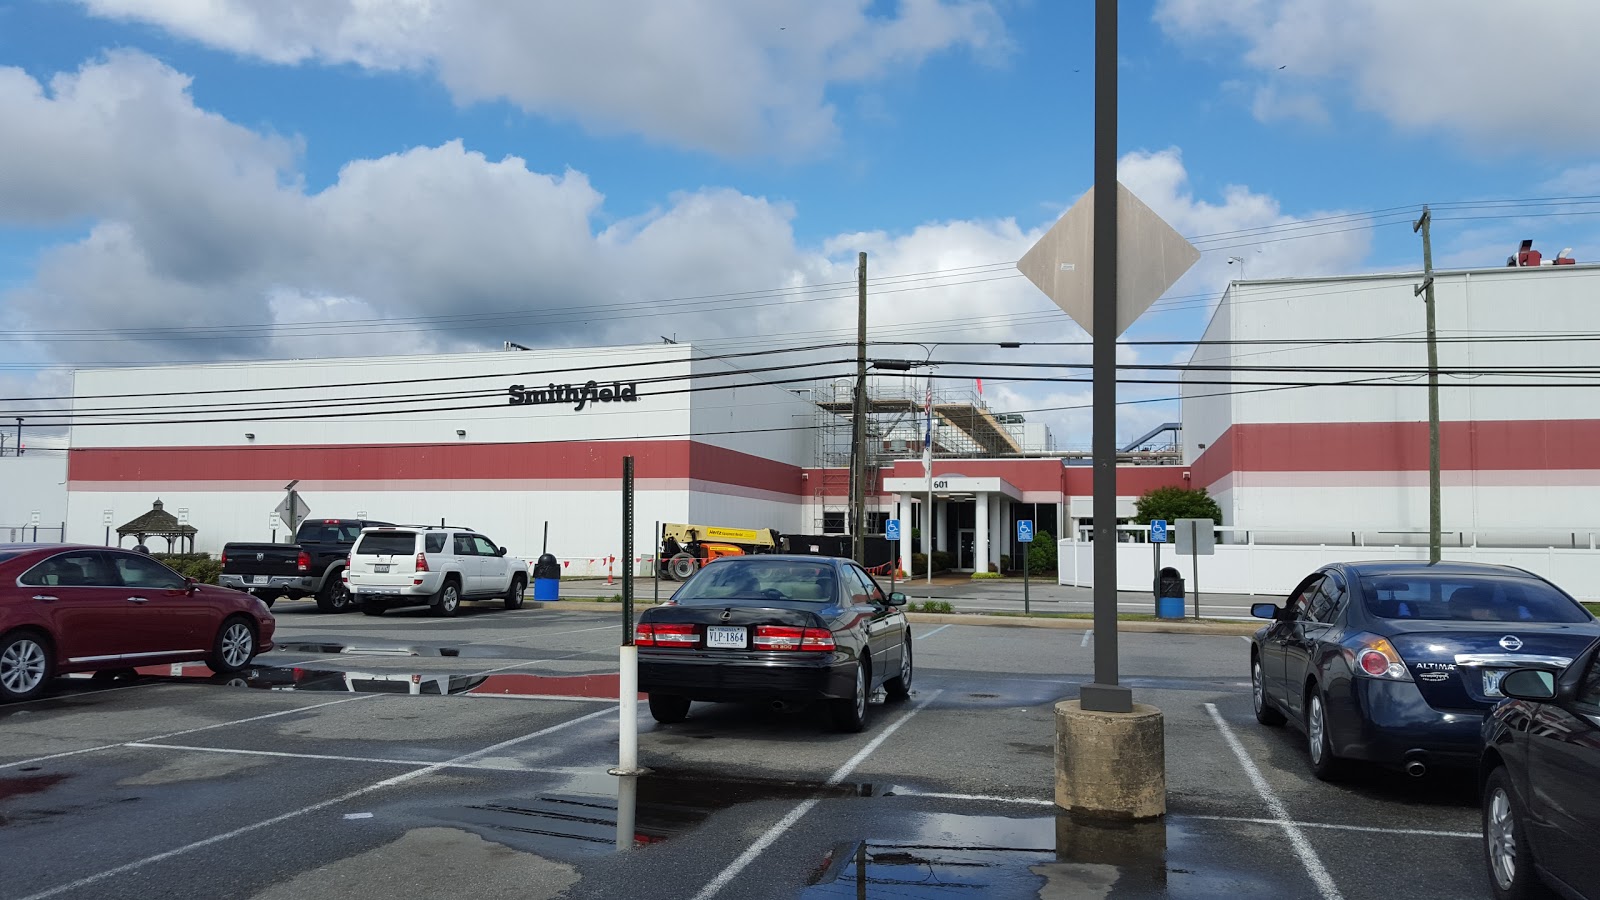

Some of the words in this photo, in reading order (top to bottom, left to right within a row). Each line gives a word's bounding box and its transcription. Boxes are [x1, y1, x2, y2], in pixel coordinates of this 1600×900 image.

[509, 380, 637, 411] Smithfield
[933, 480, 948, 489] 601
[709, 631, 744, 643] VLP-1864
[1416, 662, 1456, 671] ALTIMA
